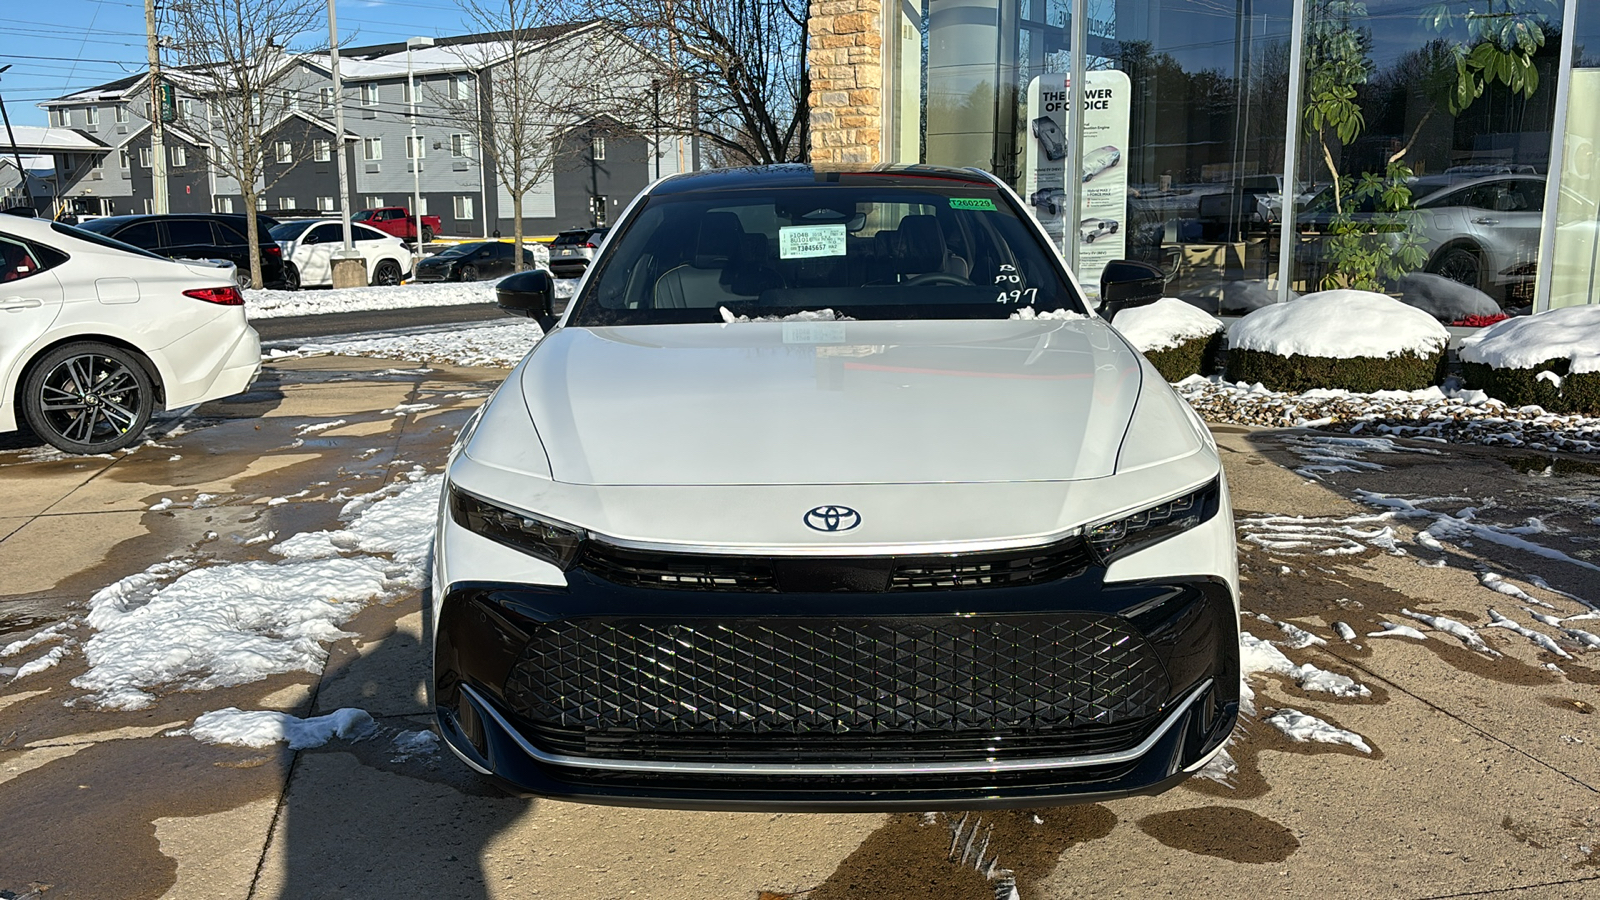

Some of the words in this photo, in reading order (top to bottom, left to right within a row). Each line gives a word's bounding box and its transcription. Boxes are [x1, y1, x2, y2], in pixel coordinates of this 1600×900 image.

[1043, 91, 1066, 101] THE
[1068, 88, 1112, 100] WER
[1045, 102, 1061, 112] OF
[797, 244, 826, 252] T3045657
[996, 287, 1038, 305] 497
